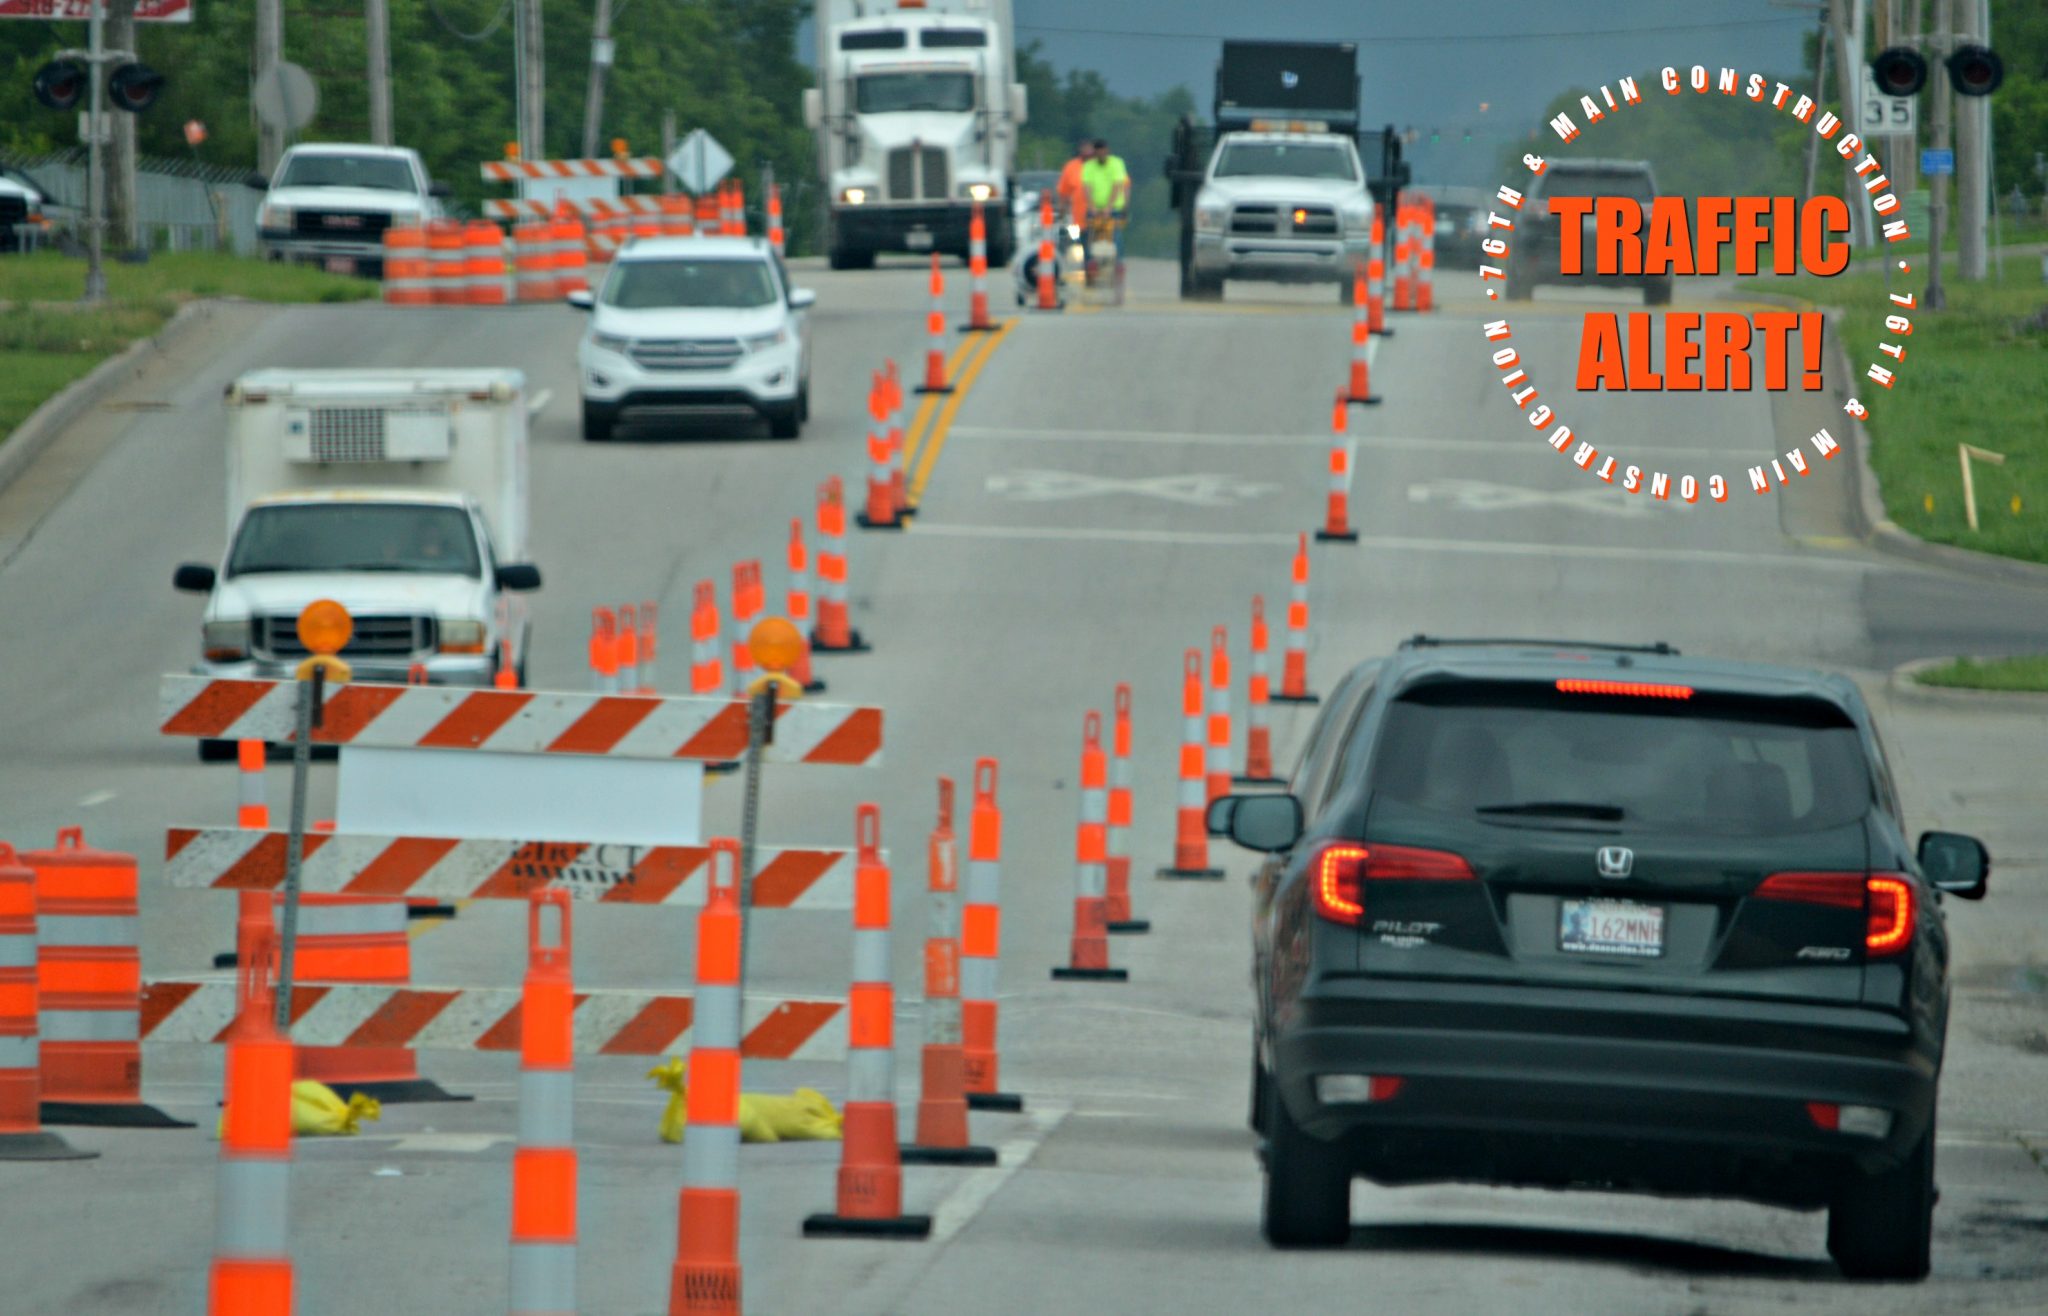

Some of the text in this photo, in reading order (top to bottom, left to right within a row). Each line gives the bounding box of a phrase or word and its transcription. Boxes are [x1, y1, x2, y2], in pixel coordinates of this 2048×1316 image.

[1865, 100, 1910, 124] 35
[1373, 920, 1442, 934] PILOT
[1591, 916, 1663, 943] 162MNH
